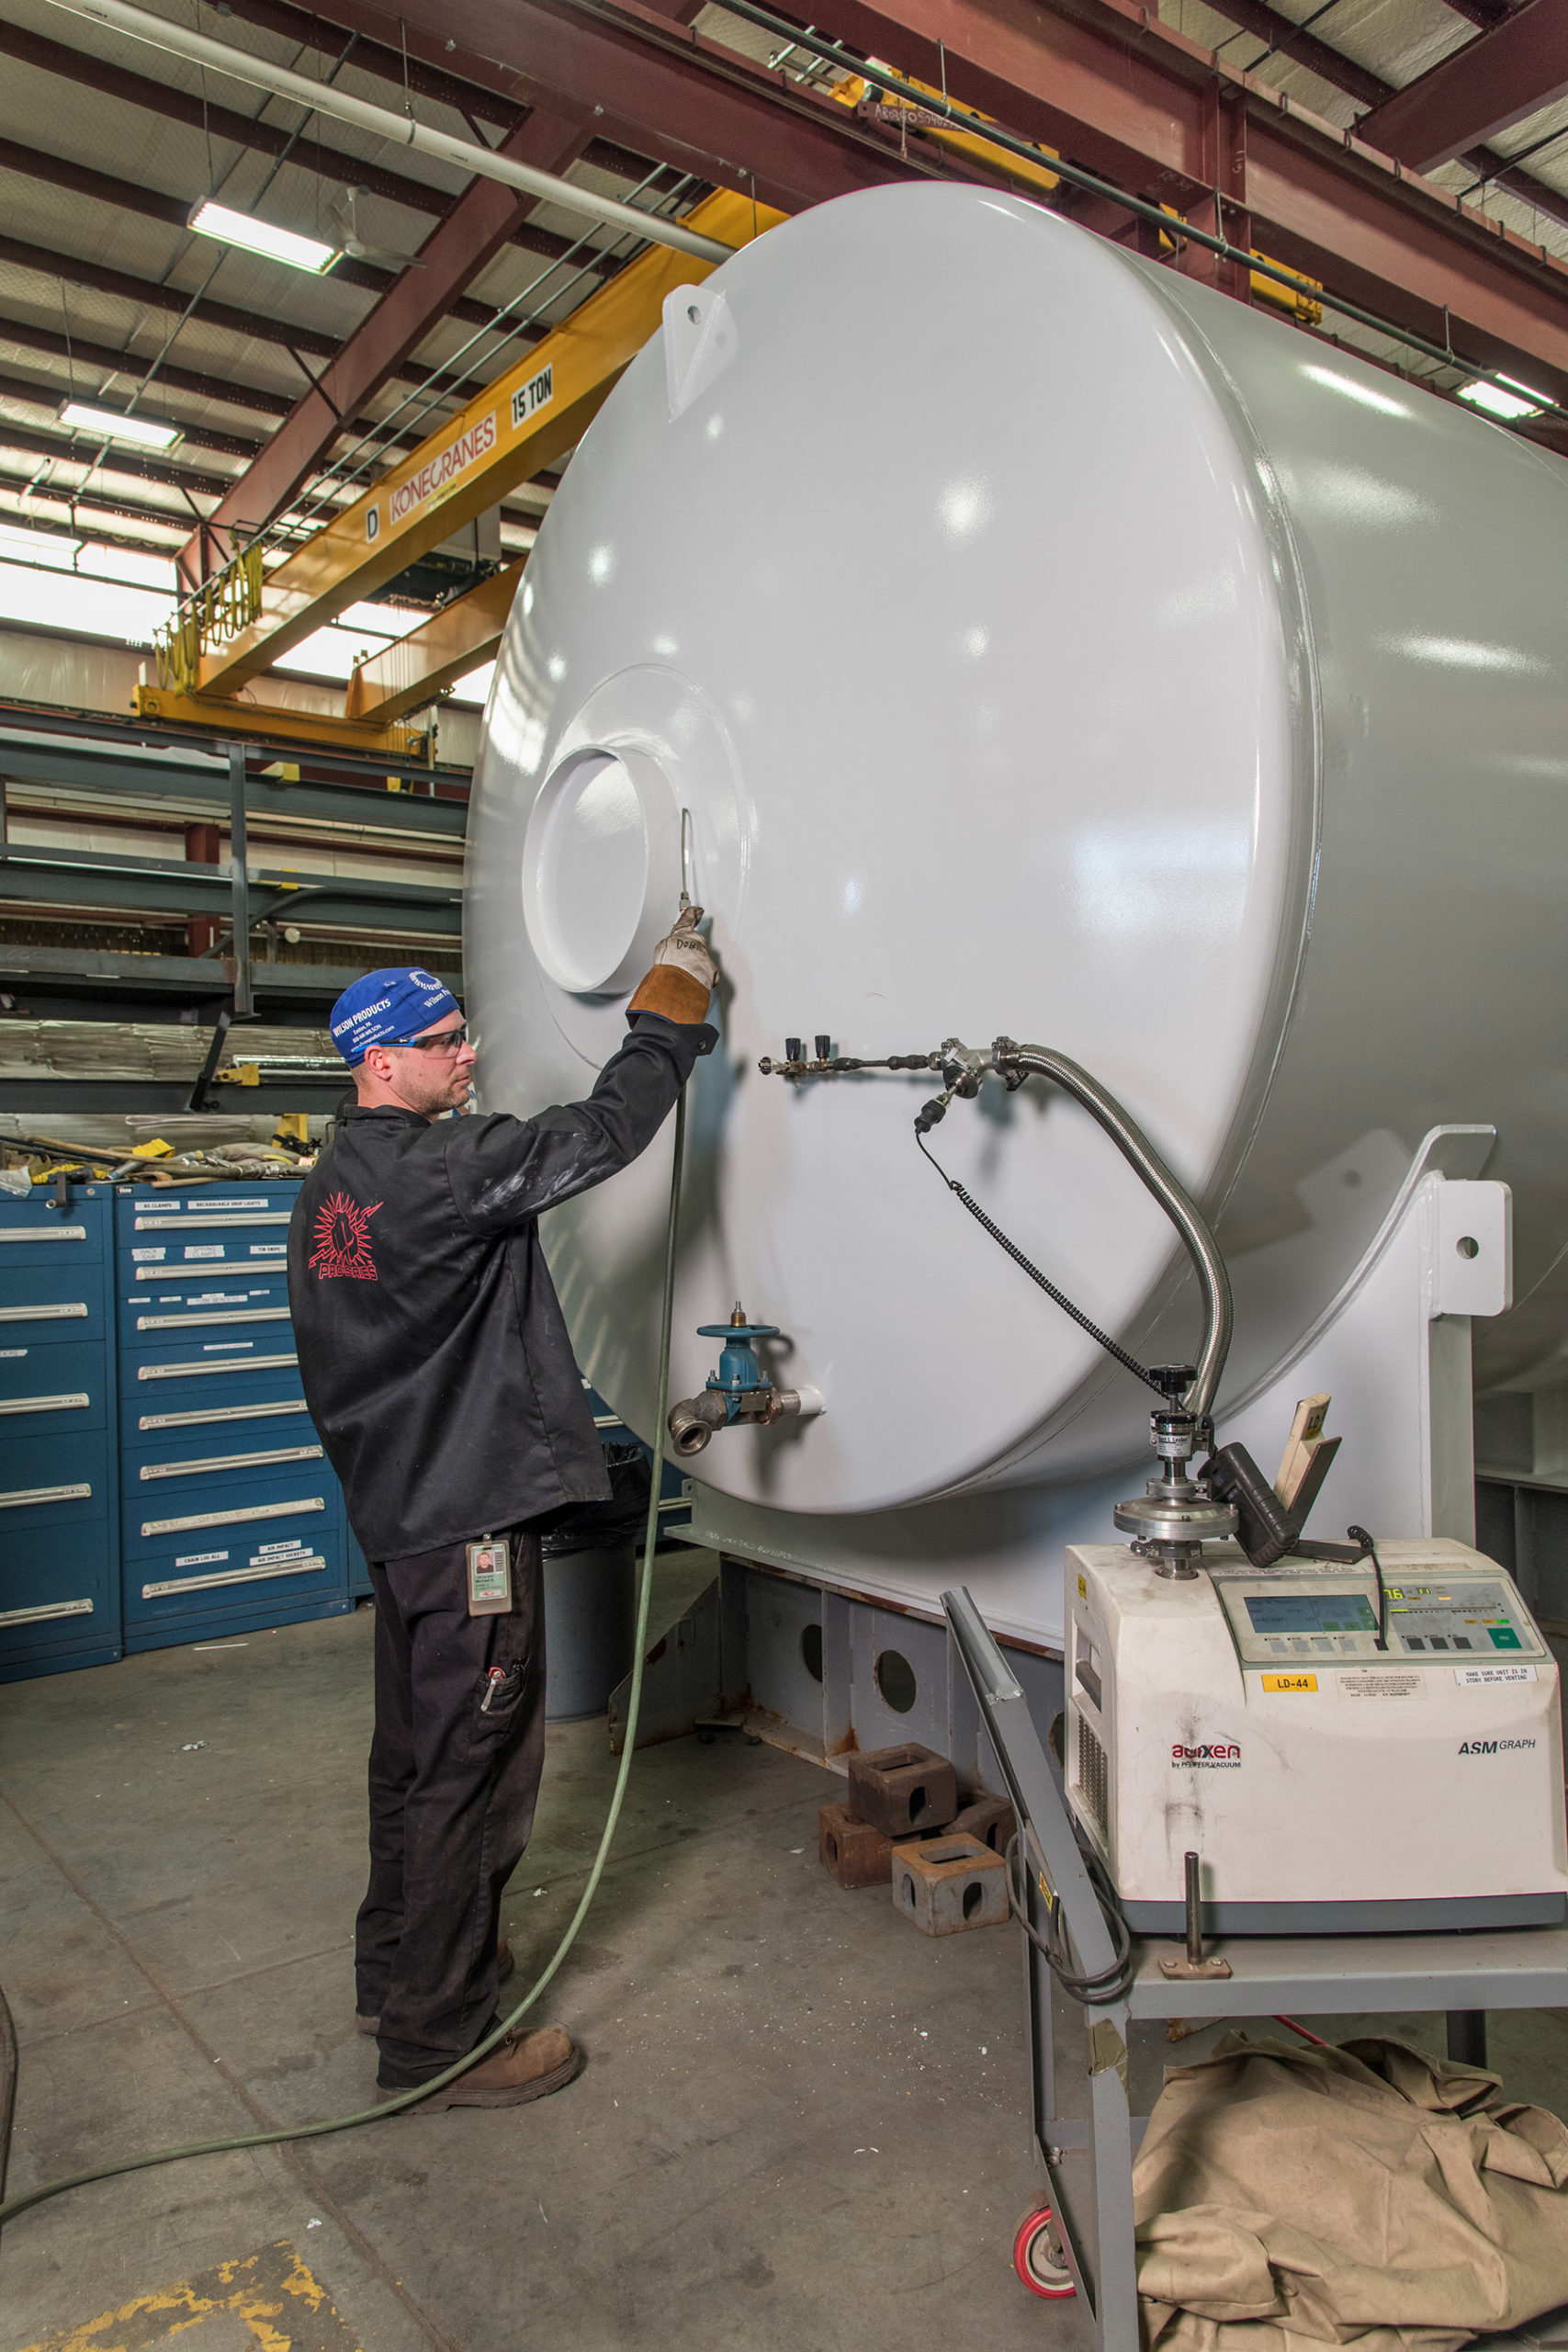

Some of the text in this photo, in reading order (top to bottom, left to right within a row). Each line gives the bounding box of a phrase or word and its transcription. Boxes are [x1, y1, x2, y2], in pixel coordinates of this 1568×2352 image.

[513, 368, 552, 424] 15 TON
[390, 415, 494, 523] KONECRANES
[367, 508, 378, 539] D
[333, 998, 391, 1037] WILSON PRODUCTS
[1278, 1679, 1308, 1689] LD-44
[1458, 1738, 1536, 1755] ASM GRAPH
